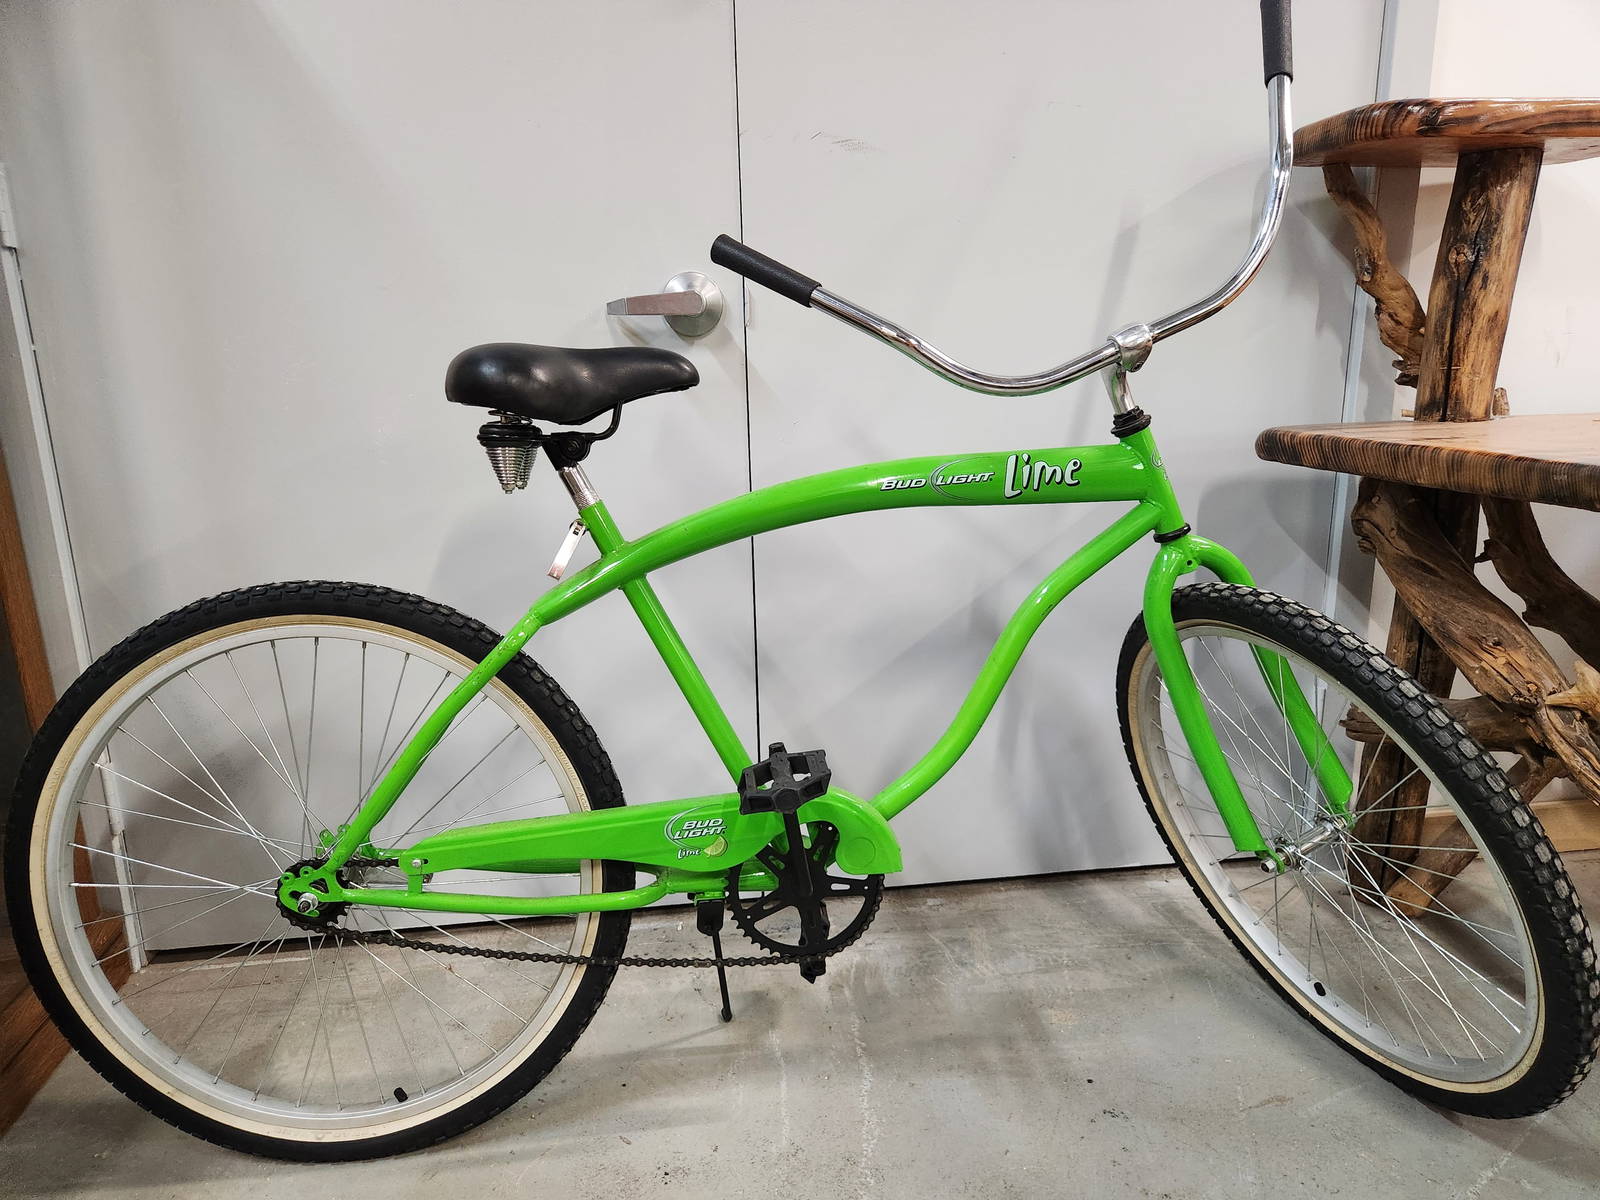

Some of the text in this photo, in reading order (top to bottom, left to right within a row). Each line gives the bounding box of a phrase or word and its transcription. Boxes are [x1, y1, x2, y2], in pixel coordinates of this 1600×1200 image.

[880, 453, 1081, 498] BUD LIGHT Lime
[682, 818, 723, 830] BUD
[673, 826, 726, 839] LIGHT
